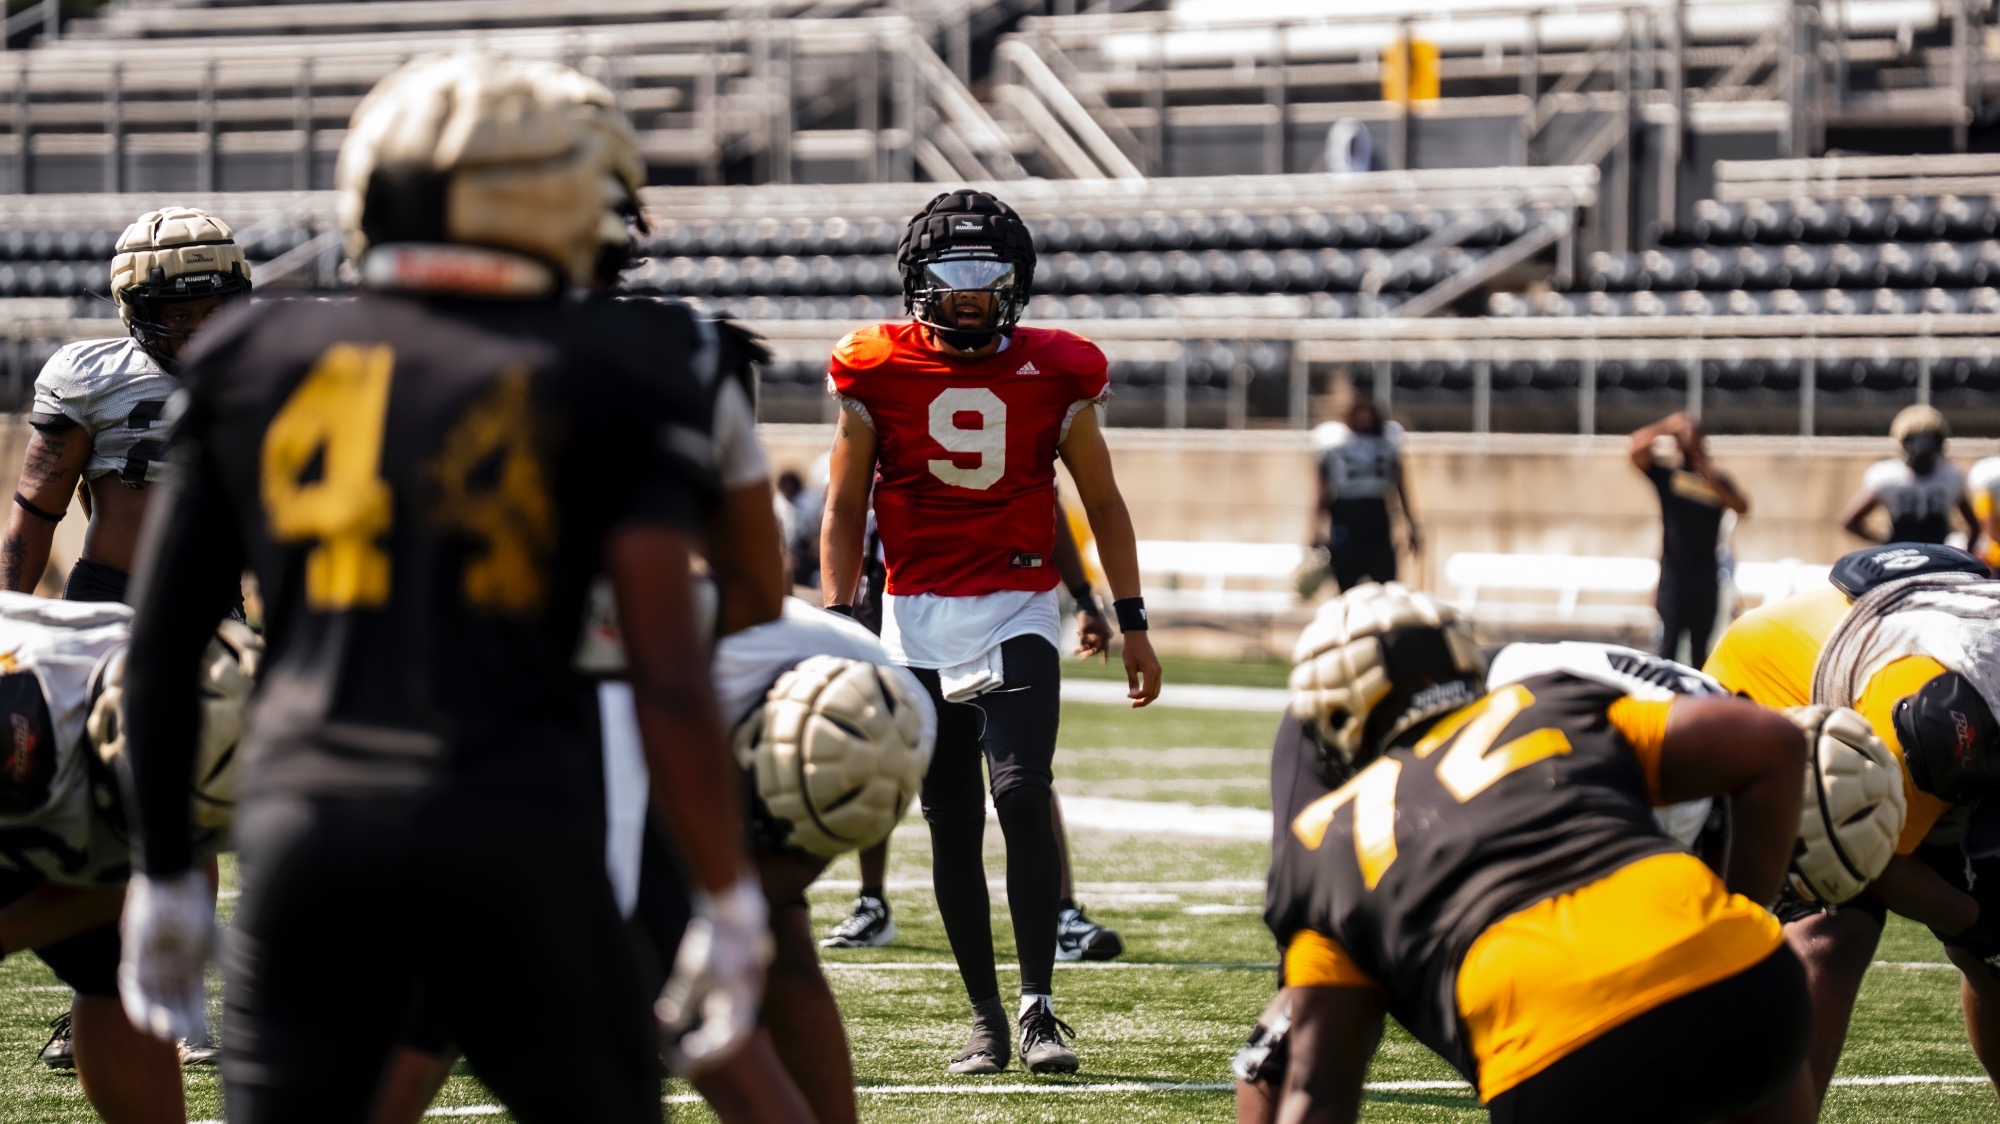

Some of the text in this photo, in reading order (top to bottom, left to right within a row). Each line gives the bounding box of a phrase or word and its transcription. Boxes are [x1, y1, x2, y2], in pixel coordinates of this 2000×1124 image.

[260, 341, 552, 611] 44
[928, 387, 1007, 490] 9
[1291, 683, 1573, 892] 72
